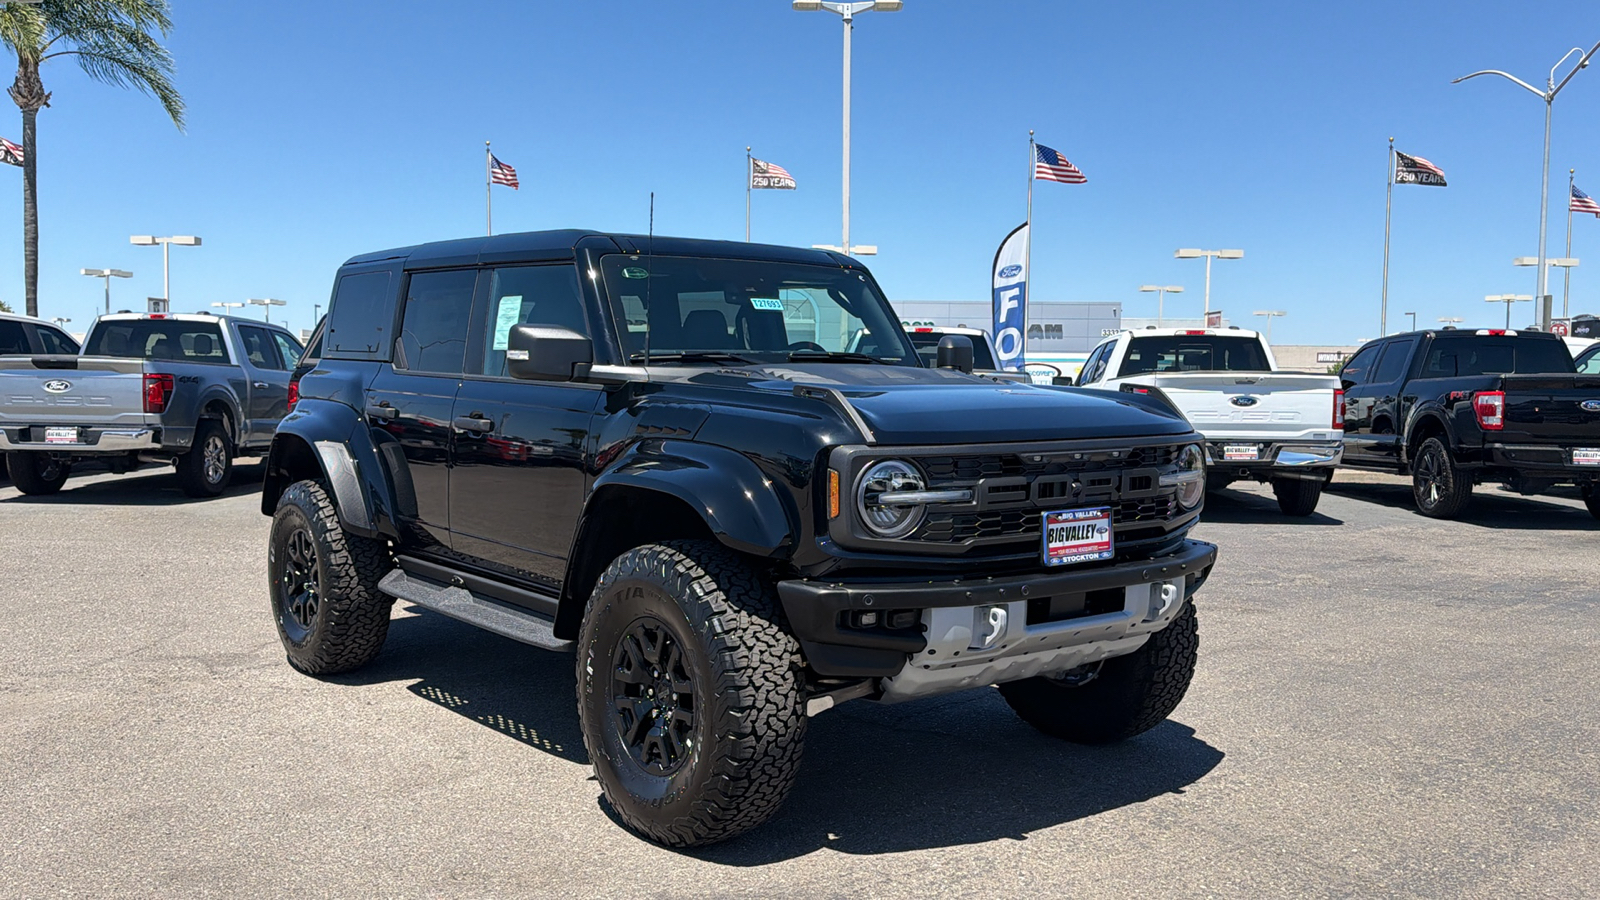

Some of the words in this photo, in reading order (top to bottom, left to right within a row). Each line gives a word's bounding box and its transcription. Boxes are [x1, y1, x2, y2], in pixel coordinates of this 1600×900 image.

[753, 177, 769, 186] 250
[769, 177, 796, 188] YEARS
[1396, 171, 1415, 182] 250
[1000, 266, 1021, 278] Ford
[995, 287, 1022, 372] FO
[1026, 324, 1064, 339] AM
[5, 394, 113, 407] F-150
[1187, 410, 1302, 423] F-150
[978, 468, 1160, 511] FORD
[1049, 524, 1097, 543] BIGVALLEY
[1063, 553, 1099, 562] STOCKTON
[614, 586, 645, 603] T/A
